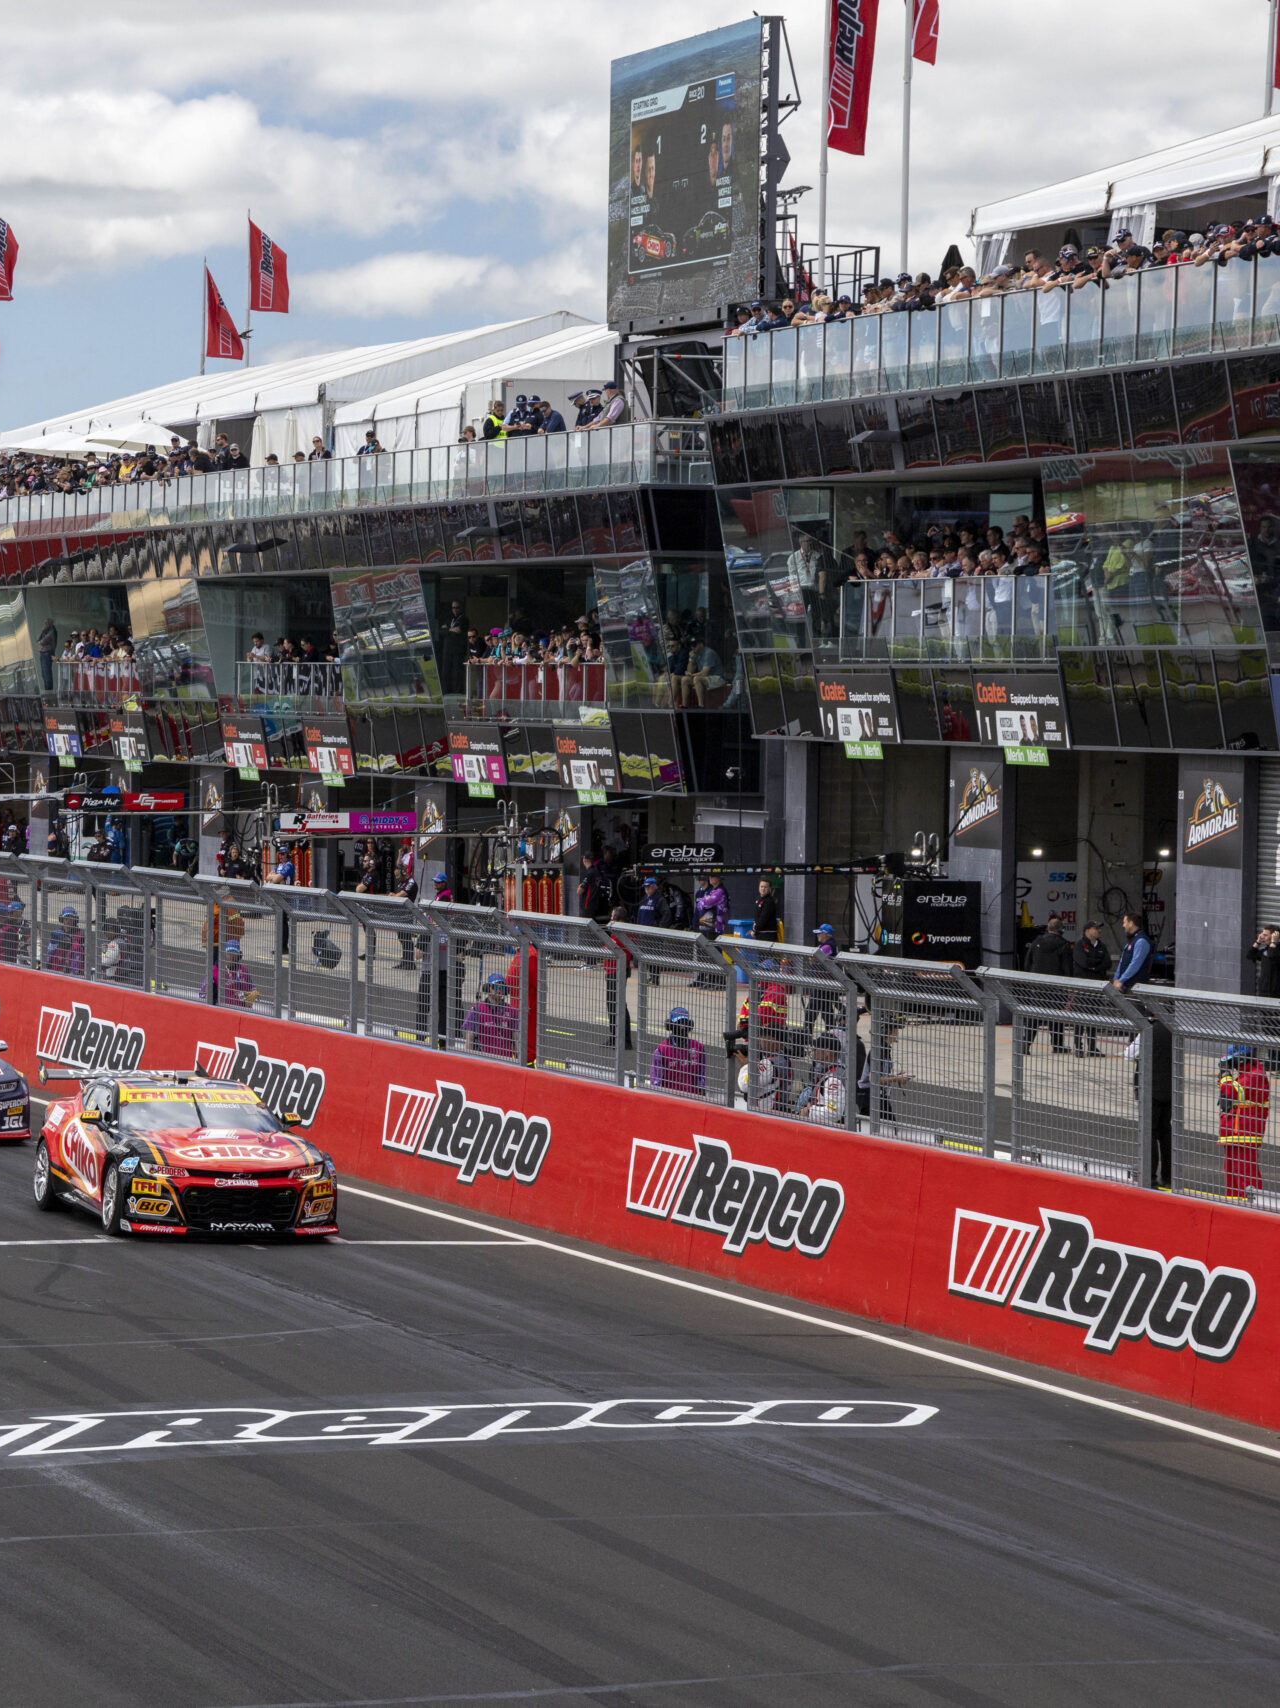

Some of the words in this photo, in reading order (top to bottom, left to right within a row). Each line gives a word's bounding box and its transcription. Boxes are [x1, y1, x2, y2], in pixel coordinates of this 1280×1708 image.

[700, 124, 707, 144] 2
[656, 135, 662, 154] 1
[820, 681, 847, 701] Coates
[872, 692, 891, 704] anything
[977, 682, 1007, 703] Coates
[1010, 693, 1030, 706] Equipped
[1038, 694, 1060, 706] anything
[827, 713, 834, 736] 9
[985, 716, 992, 740] 1
[449, 732, 469, 750] Coates
[556, 736, 577, 755] Coates
[1005, 747, 1025, 762] Merlin
[1026, 748, 1046, 763] Merlin
[453, 760, 464, 777] 14
[562, 764, 569, 784] 8
[81, 797, 102, 807] Pizza
[103, 797, 119, 806] Hut
[306, 813, 339, 821] Batteries
[372, 815, 409, 824] MIDDY'S
[651, 846, 715, 859] erebus
[916, 894, 968, 904] erebus
[926, 933, 972, 944] Tyrepower
[62, 1002, 145, 1070] Repco
[231, 1036, 326, 1130] Repco
[128, 1091, 166, 1100] TFH
[173, 1091, 209, 1100] TFH
[215, 1092, 251, 1101] TFH
[1, 1115, 24, 1130] JGI
[286, 1113, 301, 1121] TFH
[419, 1079, 552, 1185] Repco
[64, 1122, 97, 1190] CHIKO
[177, 1145, 288, 1160] CHIKO
[157, 1165, 186, 1177] PEDDERS
[133, 1180, 160, 1193] TFH
[228, 1179, 259, 1187] PEDDERS
[314, 1181, 331, 1194] TFH
[672, 1133, 845, 1258] Repco
[1012, 1207, 1257, 1361] Repco
